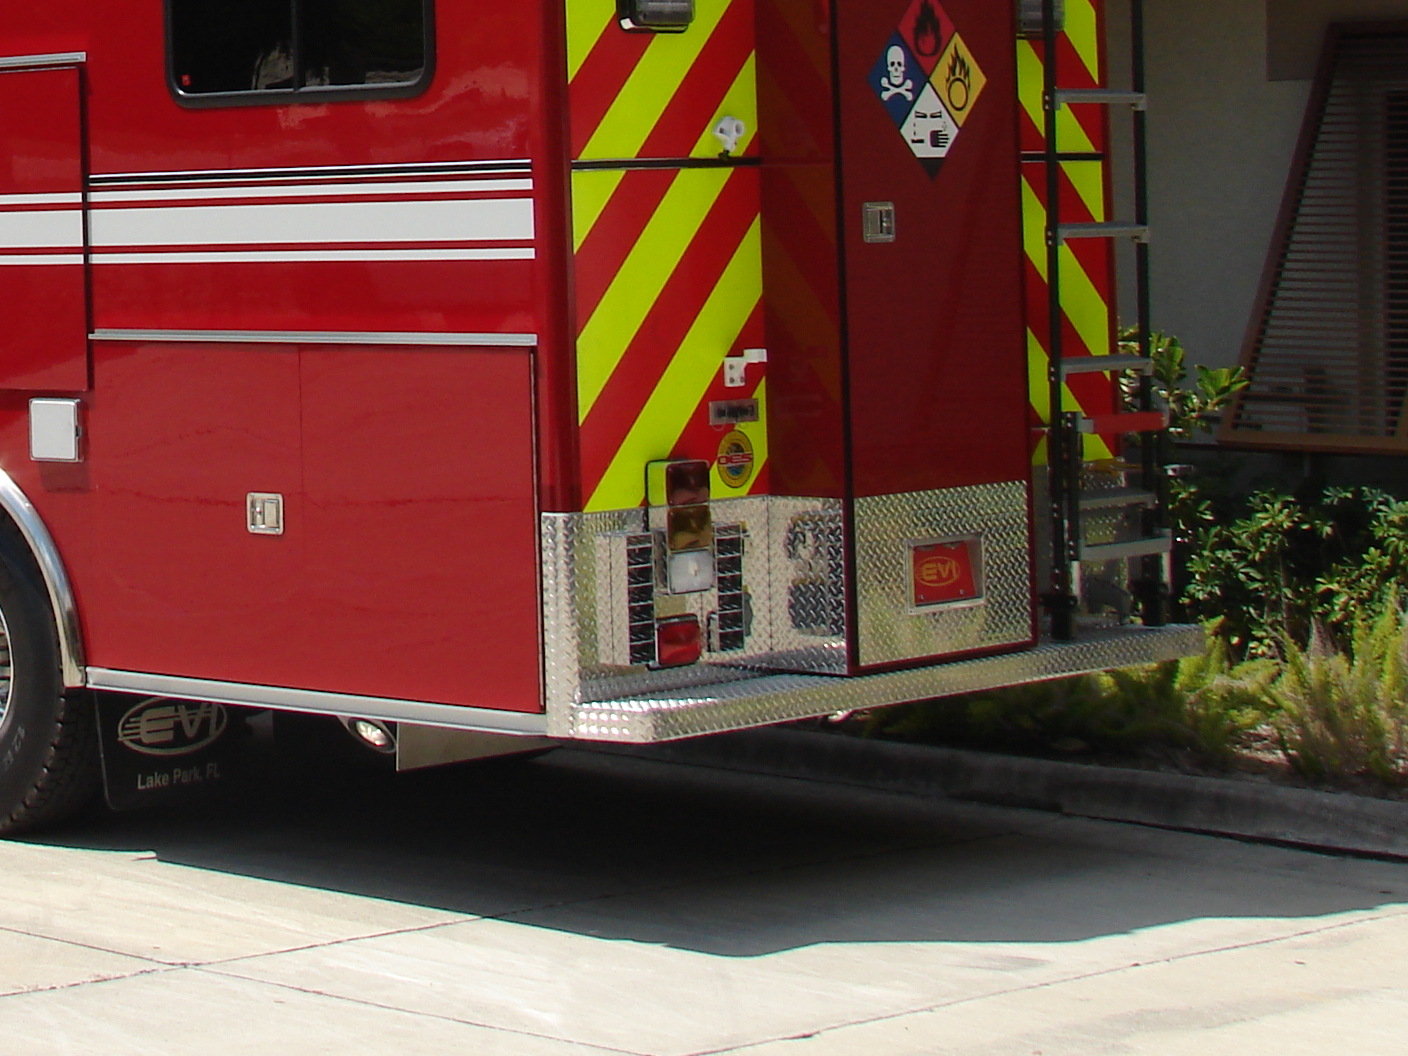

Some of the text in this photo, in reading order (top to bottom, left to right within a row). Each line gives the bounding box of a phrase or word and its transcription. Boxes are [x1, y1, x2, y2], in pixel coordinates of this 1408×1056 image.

[921, 559, 958, 582] EVI
[139, 701, 219, 744] EVI
[137, 771, 169, 790] Lake
